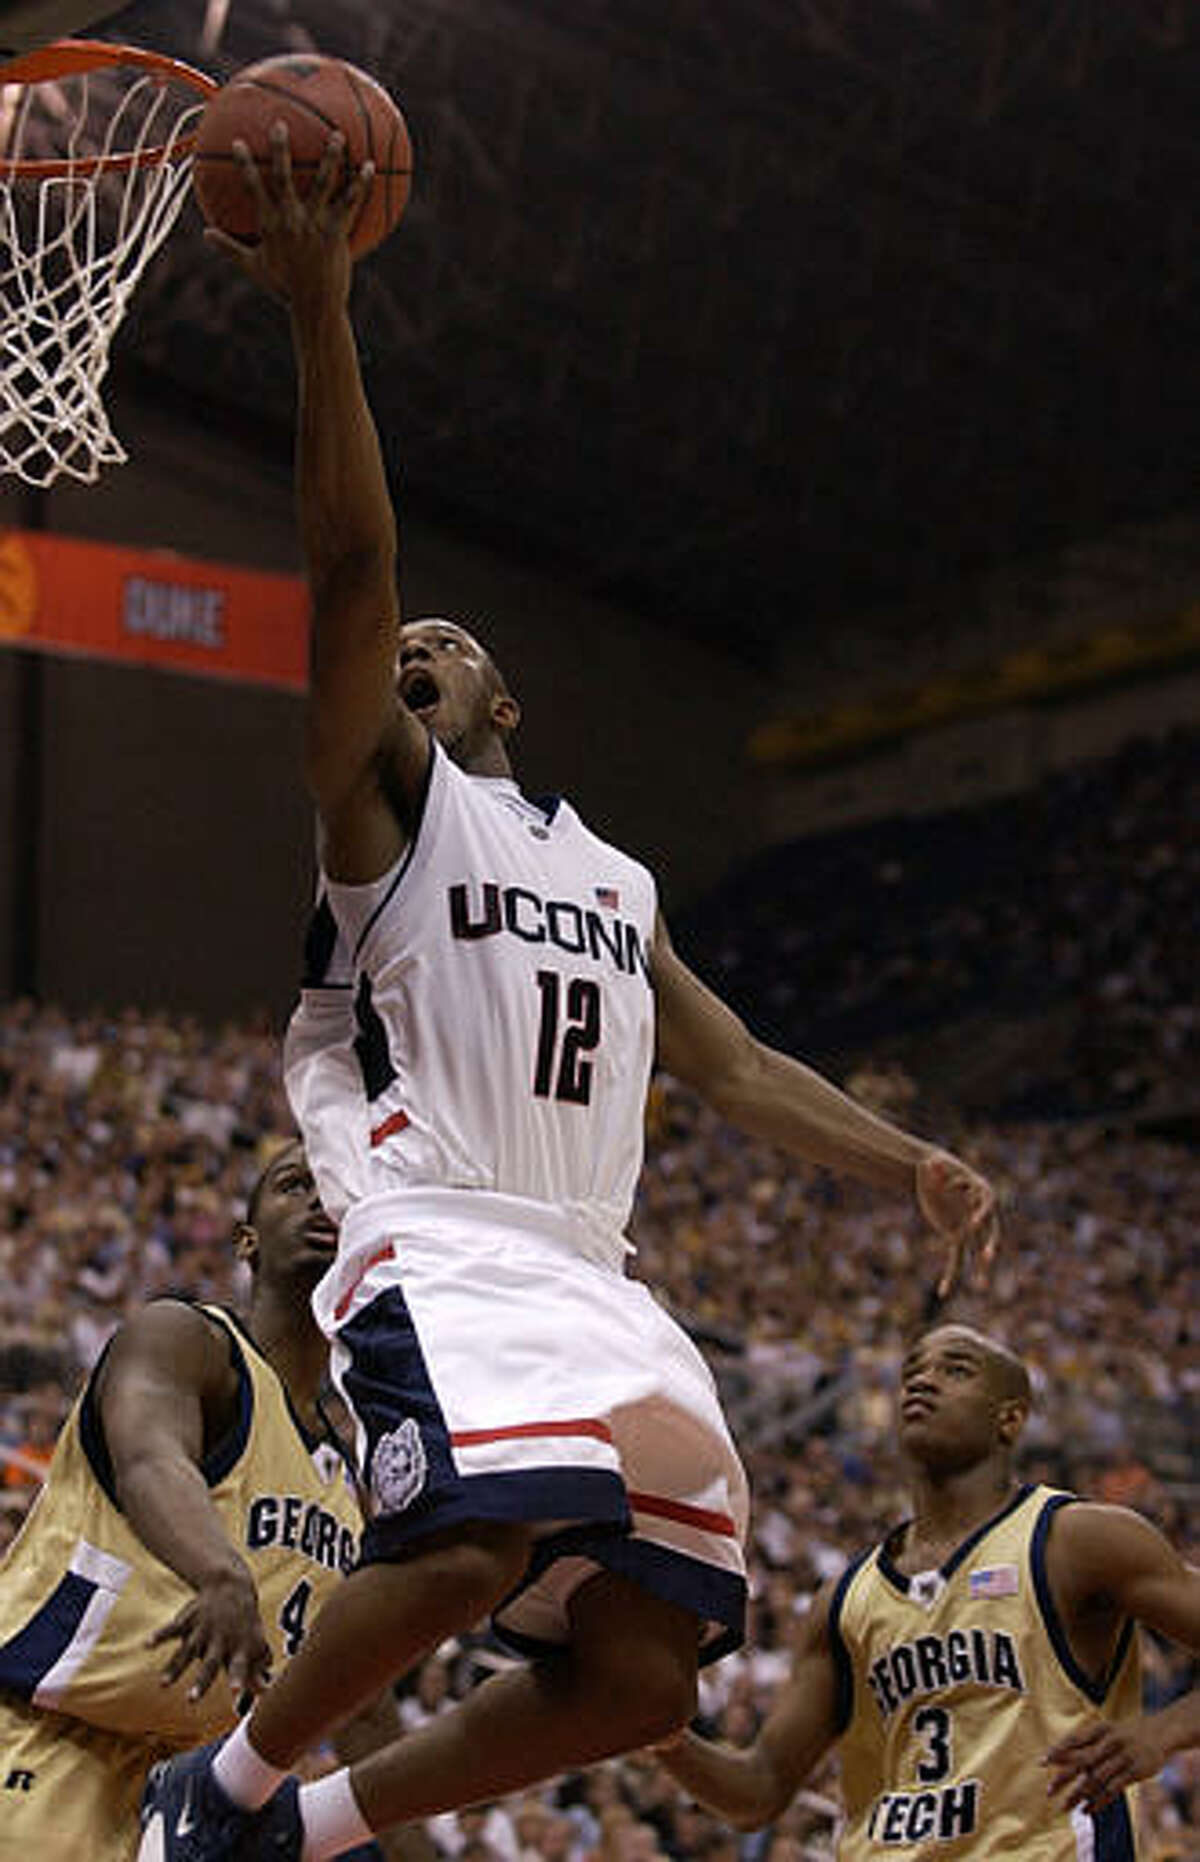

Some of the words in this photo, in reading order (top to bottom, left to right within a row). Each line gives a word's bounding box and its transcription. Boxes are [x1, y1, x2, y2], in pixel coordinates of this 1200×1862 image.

[448, 882, 652, 985] UCONN
[534, 969, 601, 1106] 12
[279, 1578, 312, 1656] 4
[868, 1630, 1023, 1716] EORGIA
[914, 1706, 951, 1784] 3
